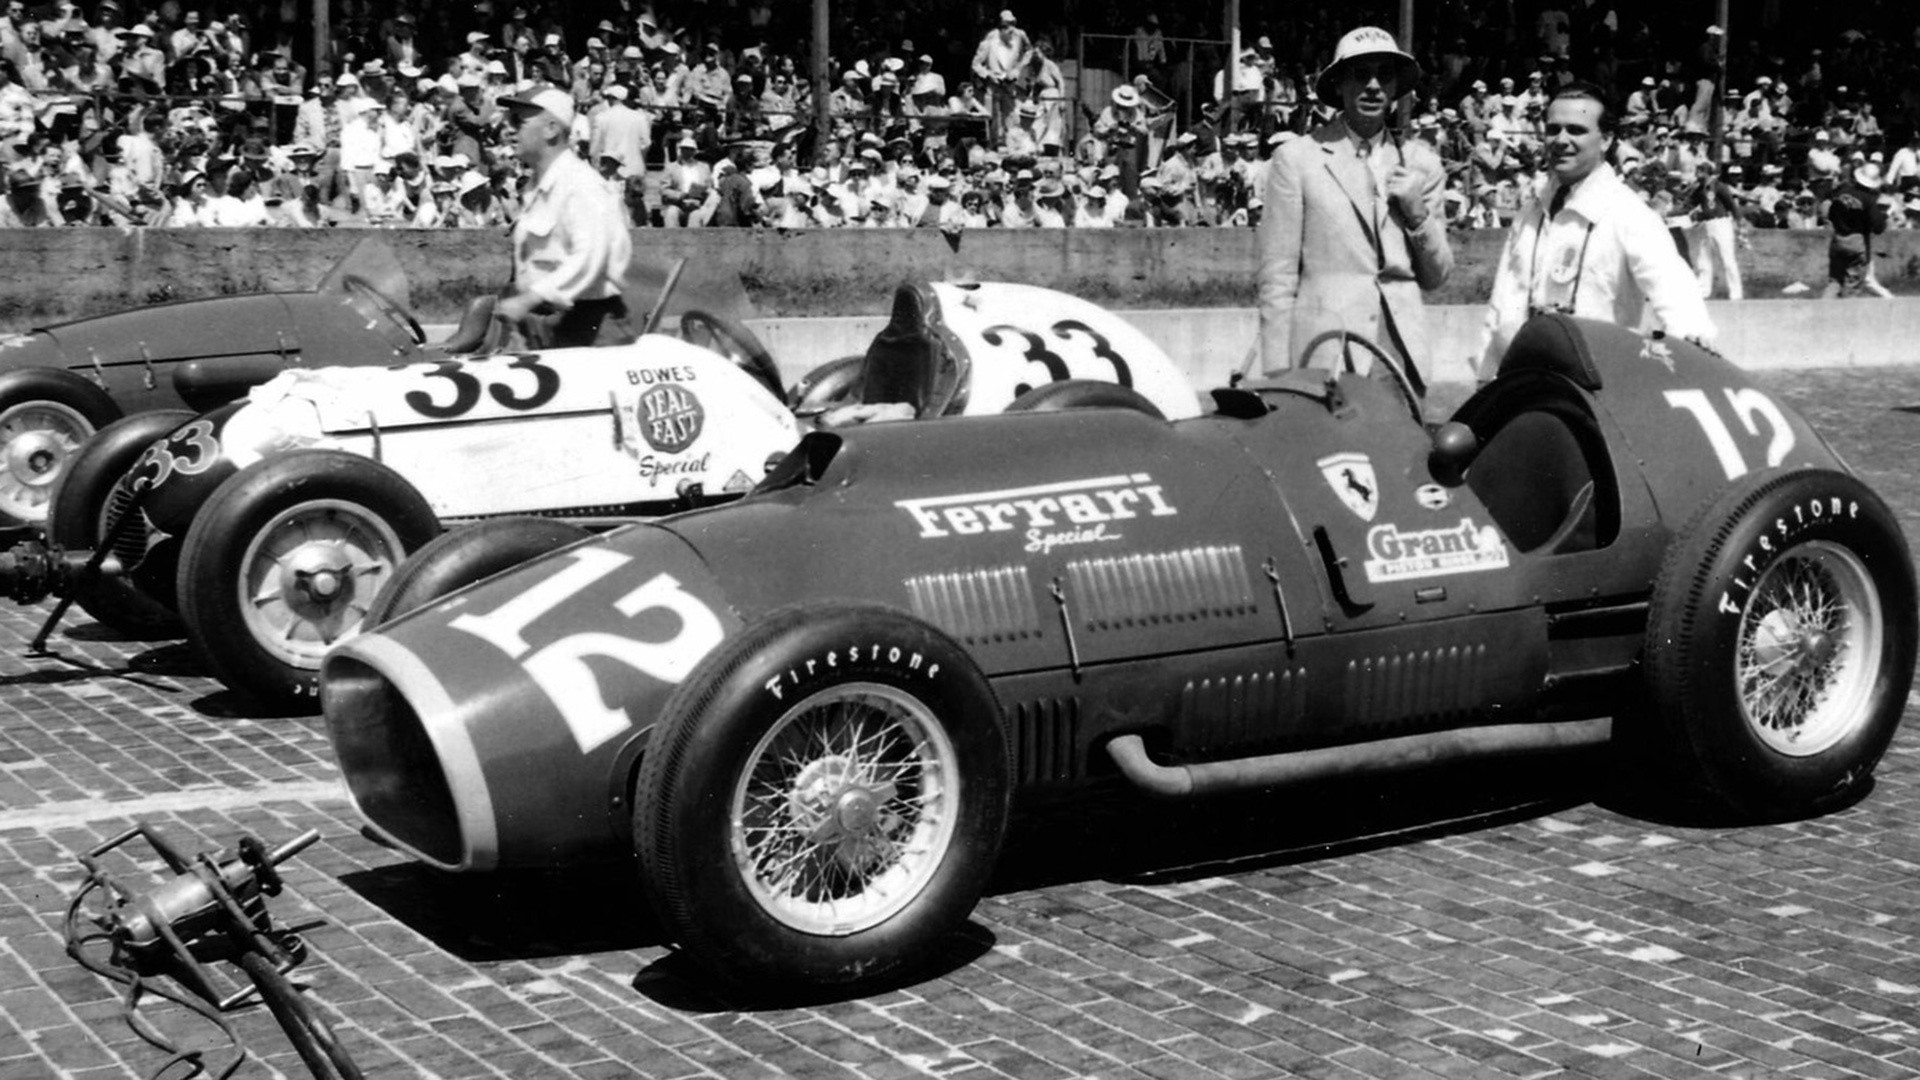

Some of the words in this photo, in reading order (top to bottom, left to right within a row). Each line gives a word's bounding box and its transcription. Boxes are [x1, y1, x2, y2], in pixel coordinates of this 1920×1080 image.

[387, 353, 561, 419] 33
[626, 366, 697, 386] BOWES
[644, 388, 695, 422] SEAL
[651, 410, 698, 445] FAST
[128, 419, 219, 491] 33
[639, 451, 711, 488] Special
[893, 472, 1177, 539] Ferrari
[1023, 523, 1123, 555] Special
[1369, 519, 1480, 561] Grant
[1718, 497, 1858, 614] Firestone
[447, 546, 726, 755] 12
[764, 644, 940, 700] Firestone
